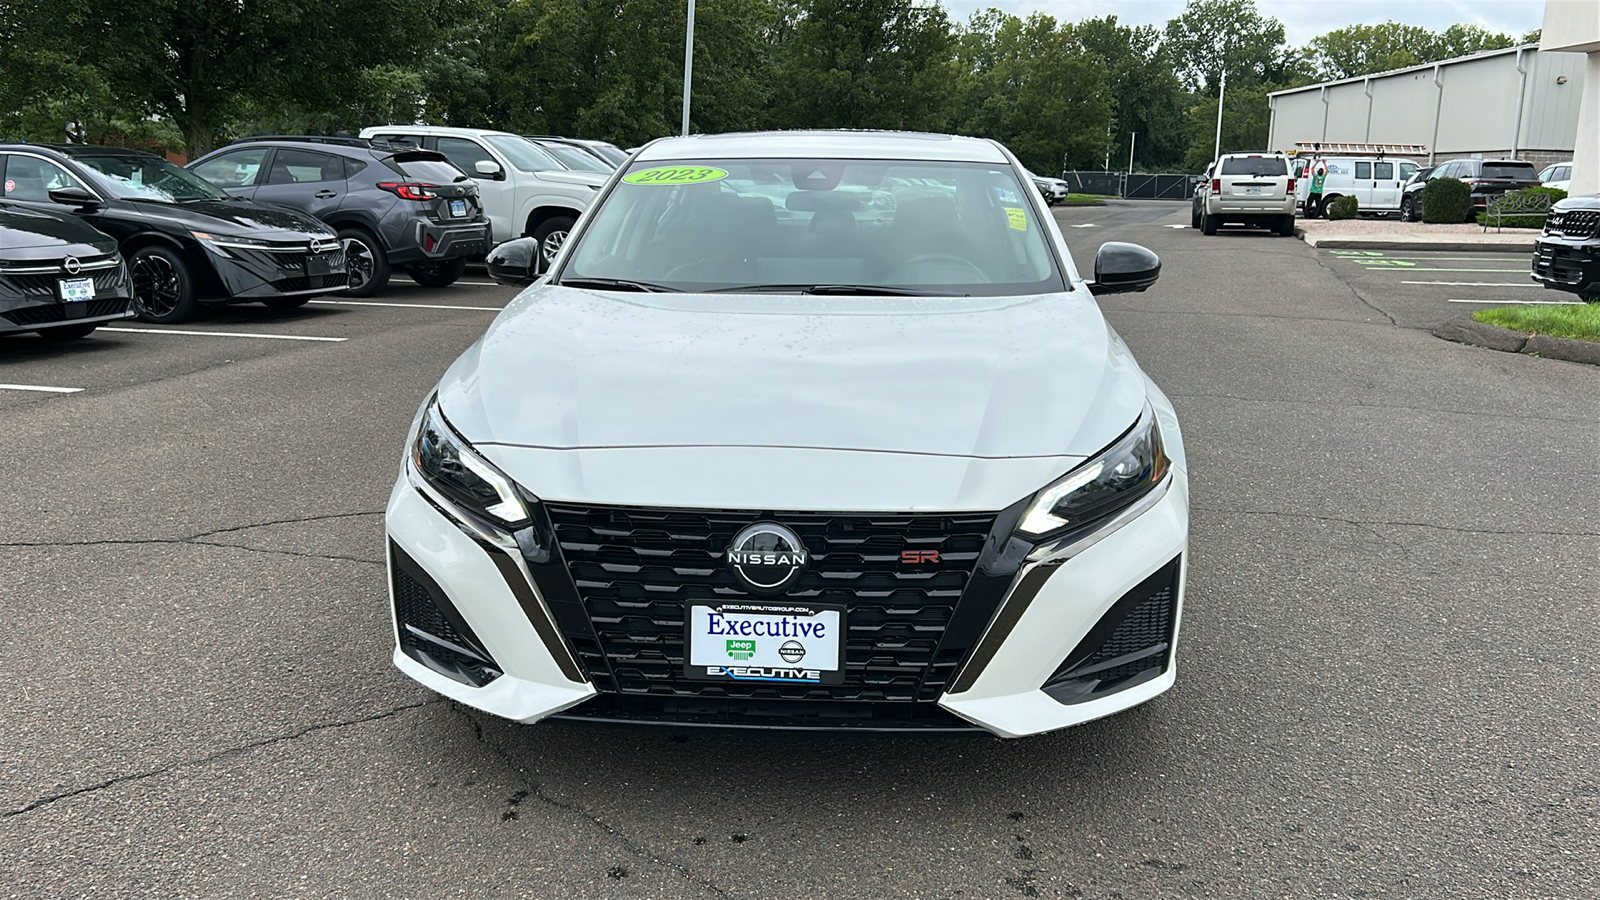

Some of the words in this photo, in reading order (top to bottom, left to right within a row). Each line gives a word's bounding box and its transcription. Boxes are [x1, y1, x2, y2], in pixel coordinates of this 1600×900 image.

[636, 169, 713, 182] 2023
[728, 552, 806, 565] NISSAN
[901, 551, 939, 563] SR
[721, 604, 809, 613] EXECUTIVEAUTOGROUP.COM
[707, 612, 826, 639] Executive
[730, 640, 752, 650] Jeep
[706, 666, 821, 679] EXECUTIVE
